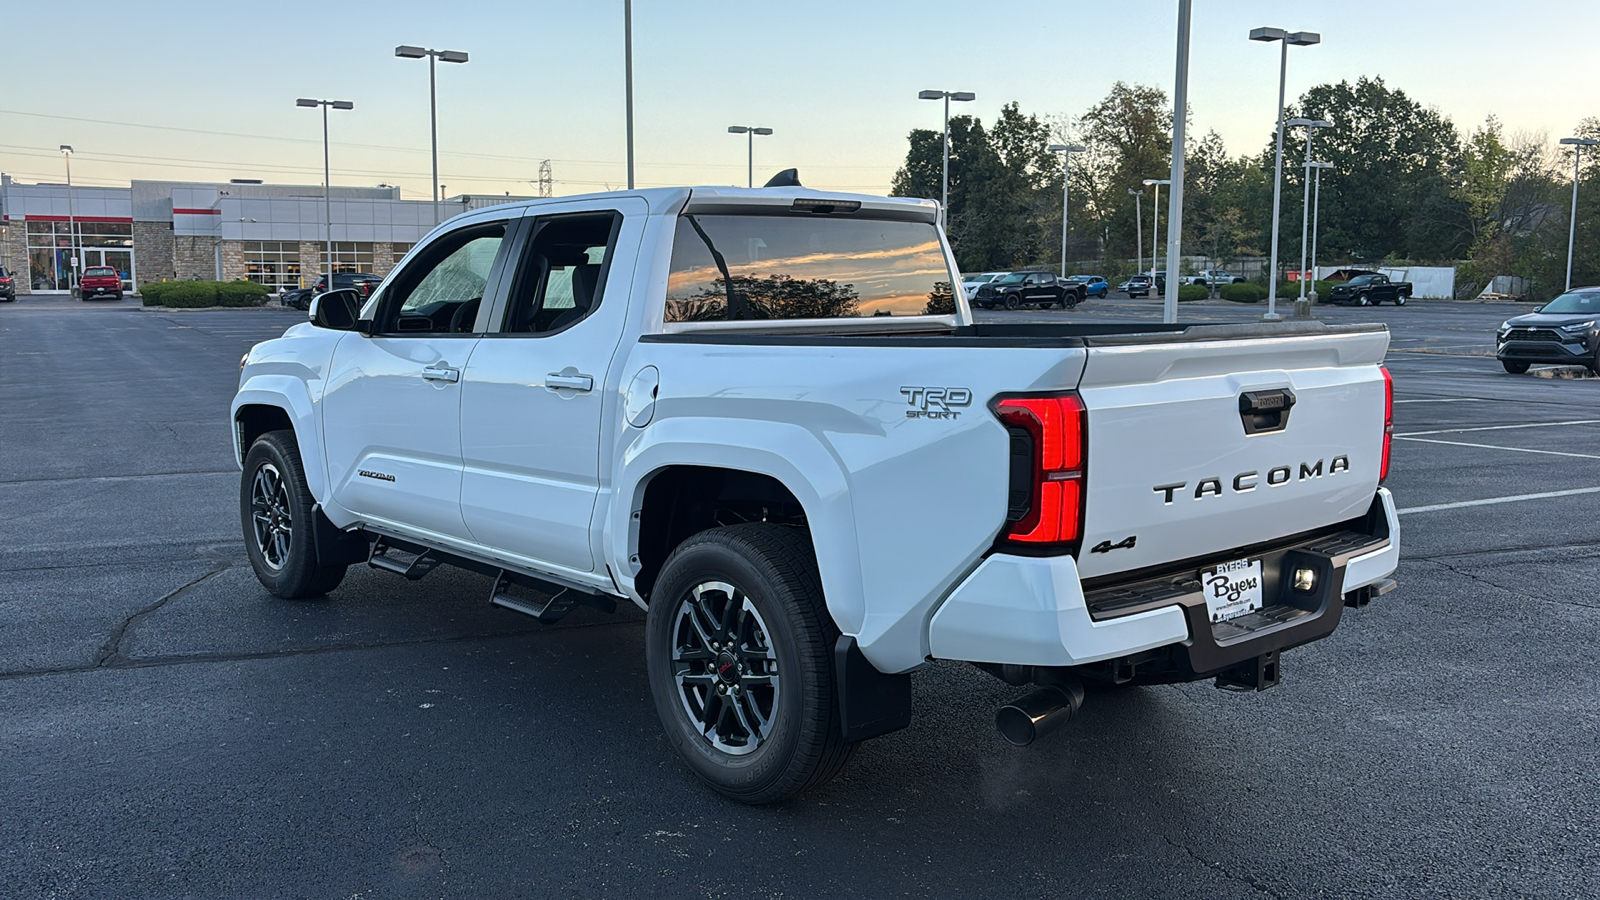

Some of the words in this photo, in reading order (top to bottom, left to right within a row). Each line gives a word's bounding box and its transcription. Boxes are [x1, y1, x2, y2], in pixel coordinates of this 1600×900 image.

[900, 386, 972, 410] TRD
[906, 411, 961, 420] SPORT
[358, 469, 396, 482] TACOMA
[1153, 454, 1350, 504] TACOMA
[1217, 558, 1248, 574] BYERS
[1206, 576, 1257, 602] Byers
